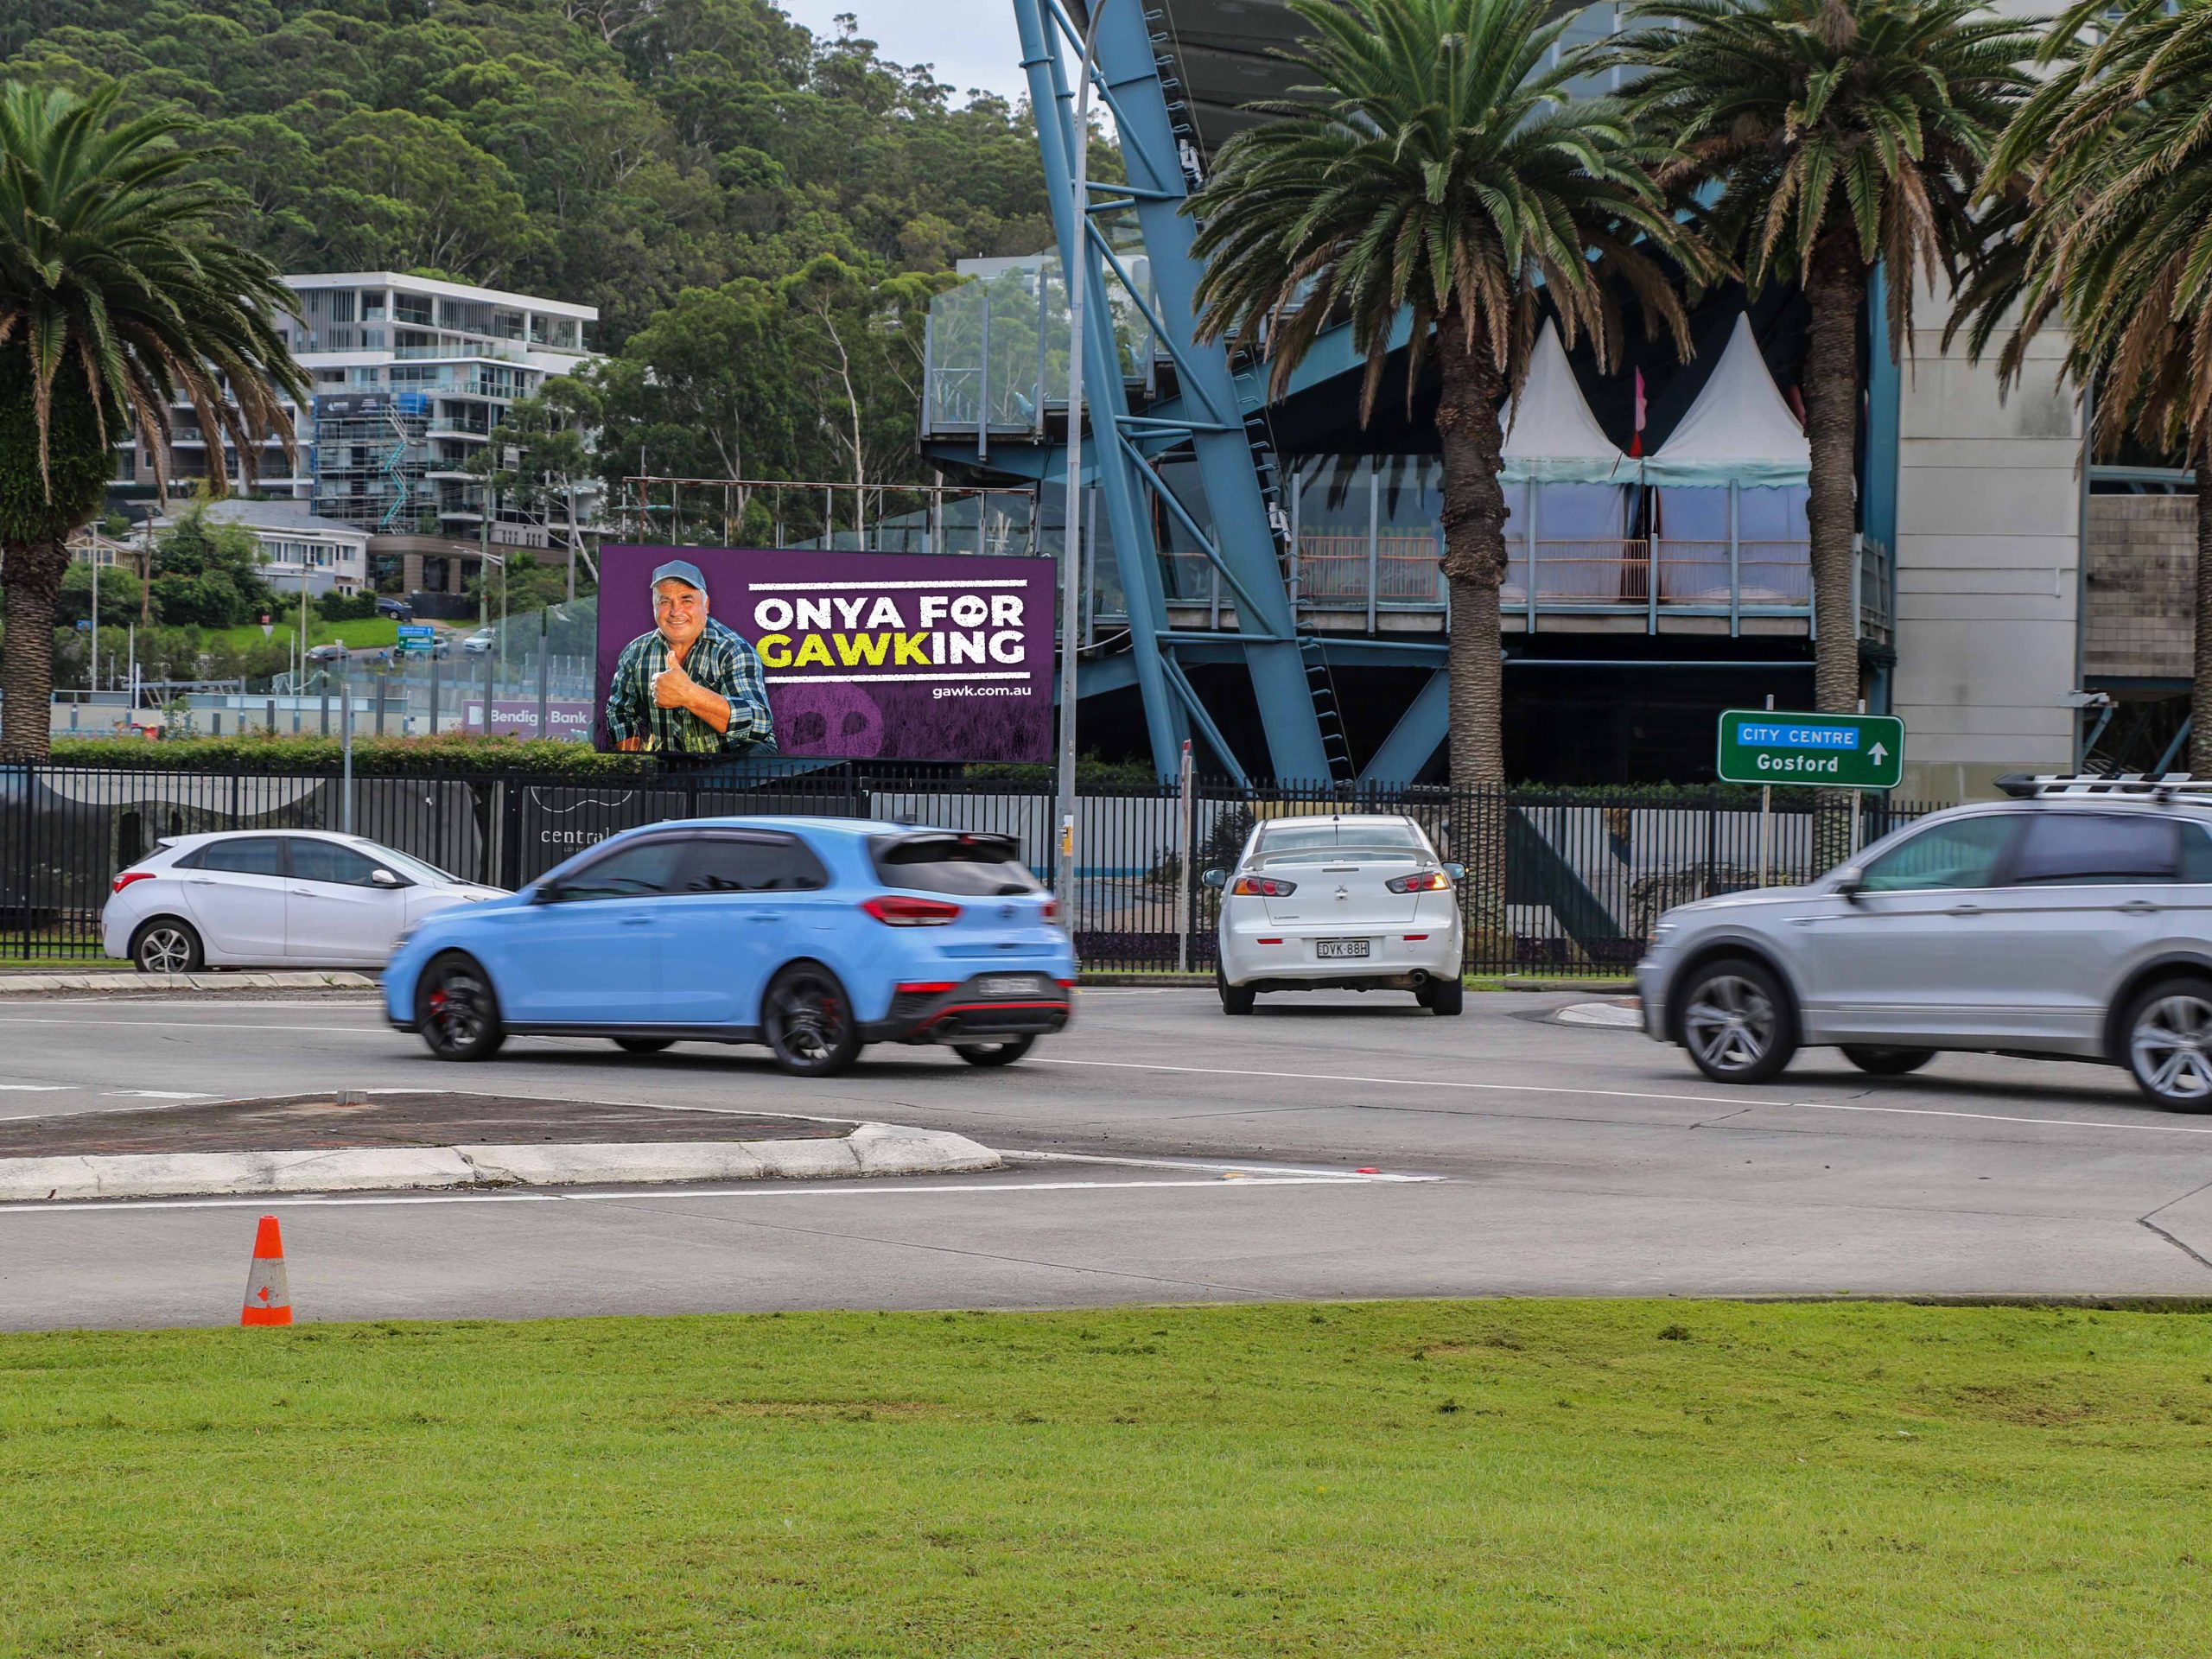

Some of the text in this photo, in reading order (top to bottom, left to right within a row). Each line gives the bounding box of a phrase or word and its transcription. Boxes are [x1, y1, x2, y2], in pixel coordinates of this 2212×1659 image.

[754, 594, 1025, 631] ONYA FOR
[756, 630, 1026, 668] GAWKING
[932, 685, 1032, 699] gawk.com.au
[491, 709, 588, 726] Bendig Bank
[1743, 728, 1854, 745] CITY CENTRE
[1757, 753, 1839, 772] Gosford
[541, 827, 610, 844] central
